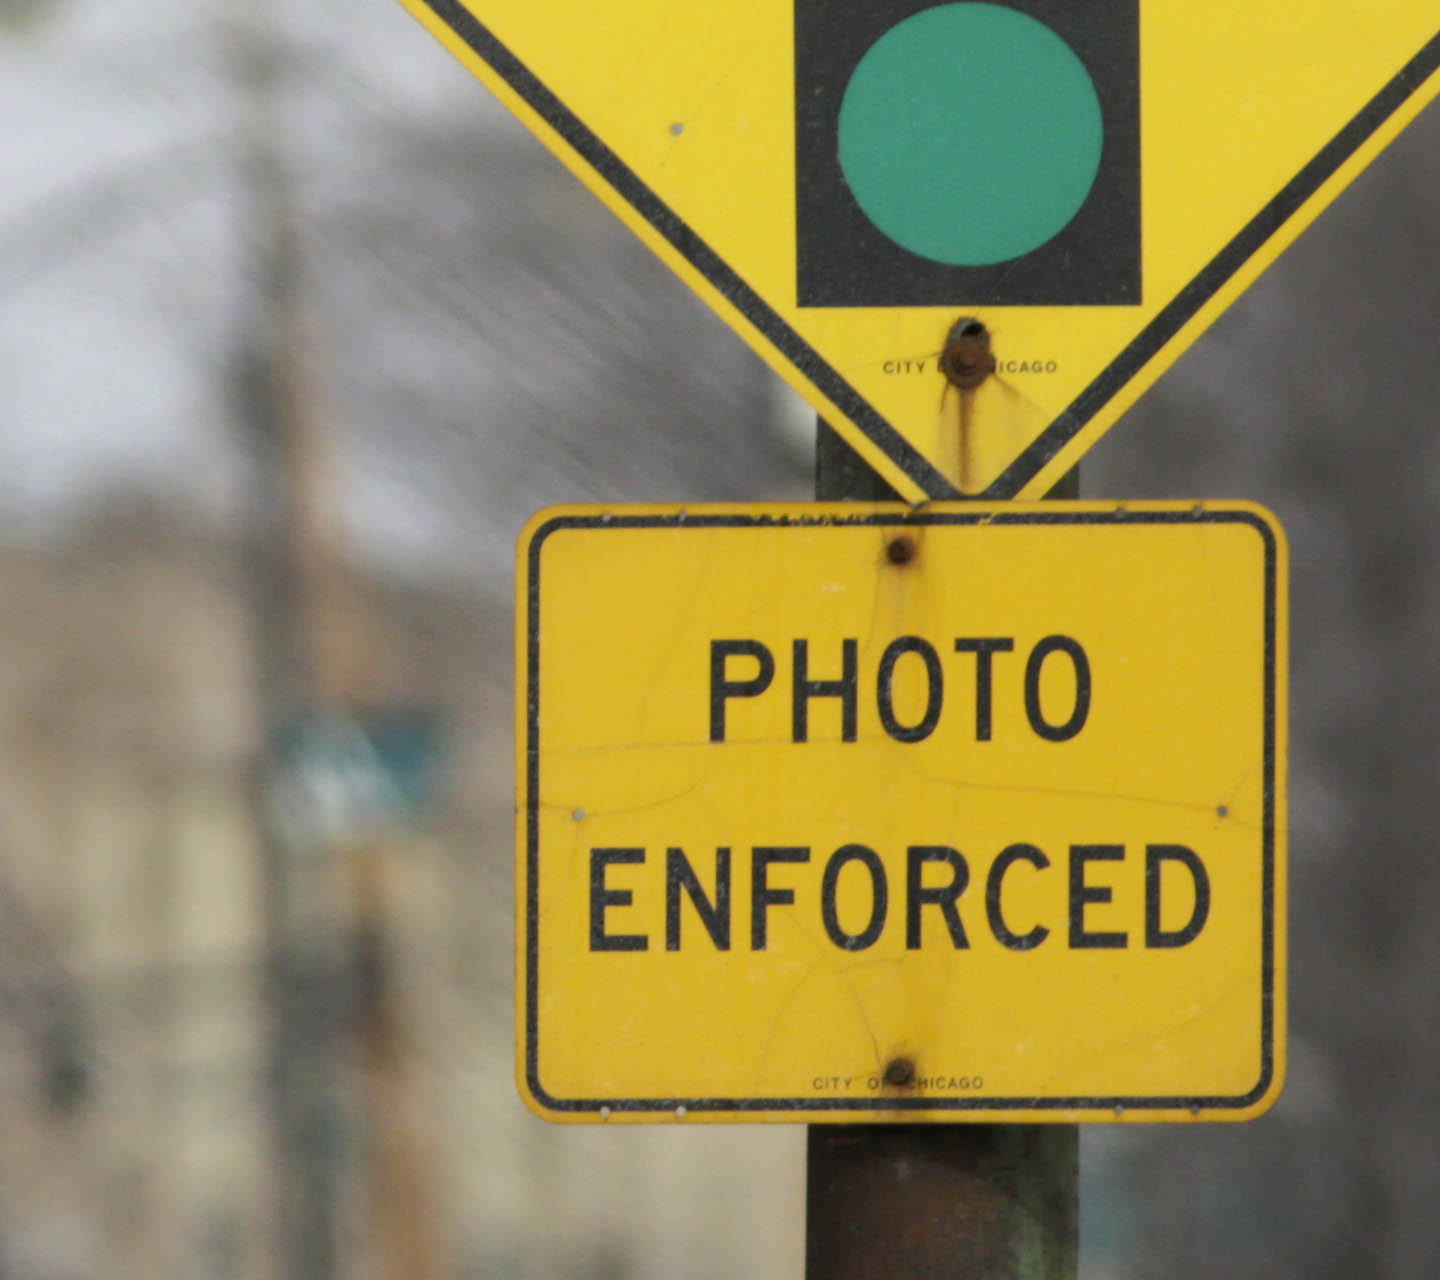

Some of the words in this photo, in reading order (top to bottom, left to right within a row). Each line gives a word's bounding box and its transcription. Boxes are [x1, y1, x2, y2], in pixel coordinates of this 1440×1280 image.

[883, 361, 925, 374] CITY
[982, 361, 1058, 374] ICAGO
[710, 635, 1092, 743] PHOTO
[589, 843, 1211, 952] ENFORCED
[813, 1077, 852, 1090] CITY
